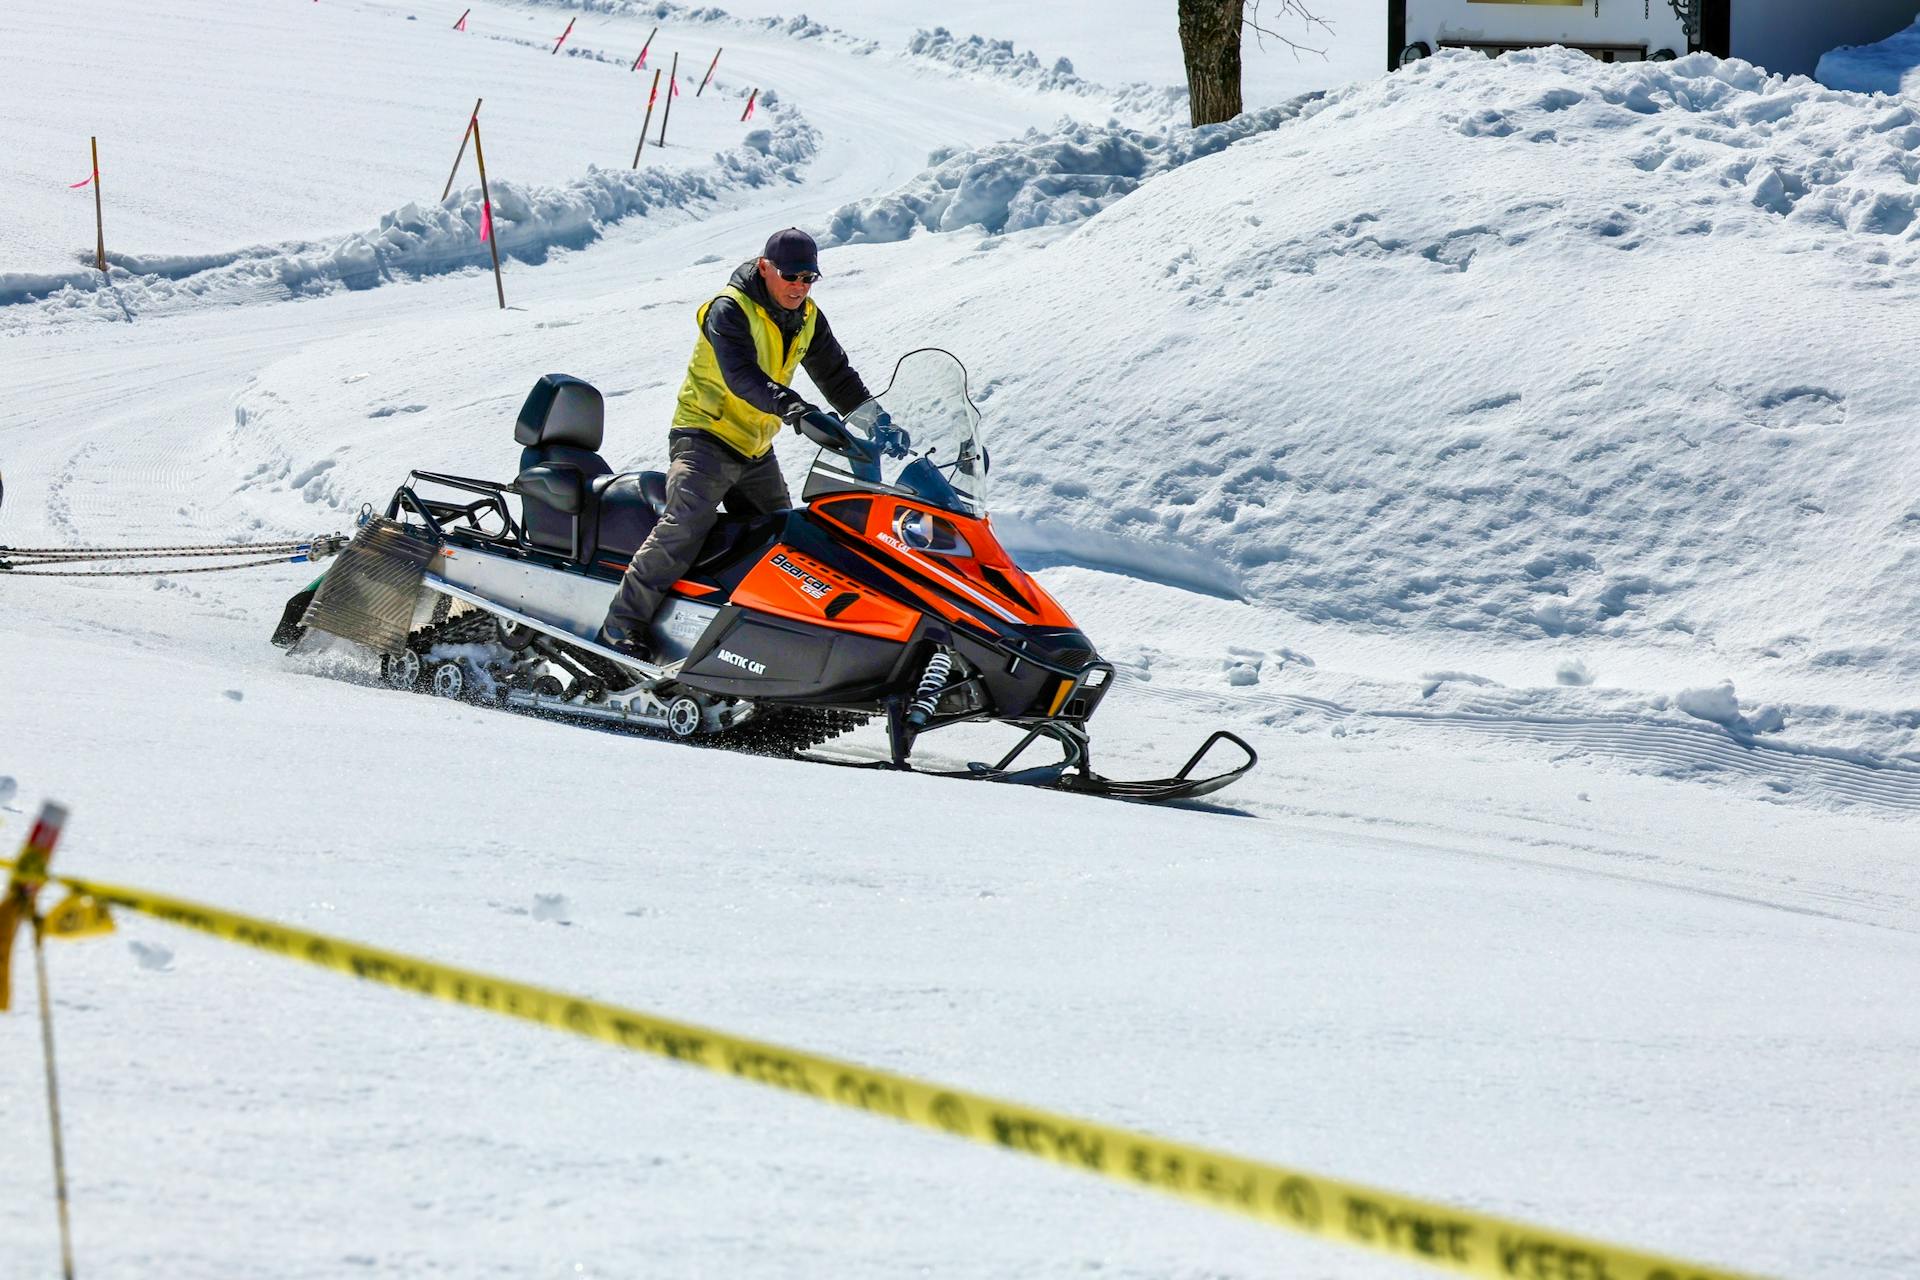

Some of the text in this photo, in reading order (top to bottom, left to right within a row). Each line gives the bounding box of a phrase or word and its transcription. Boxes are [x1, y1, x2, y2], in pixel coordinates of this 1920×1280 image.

[876, 532, 912, 553] ARCTIC CAT
[769, 553, 833, 595] Bearcat
[717, 649, 766, 675] ARCTIC CAT
